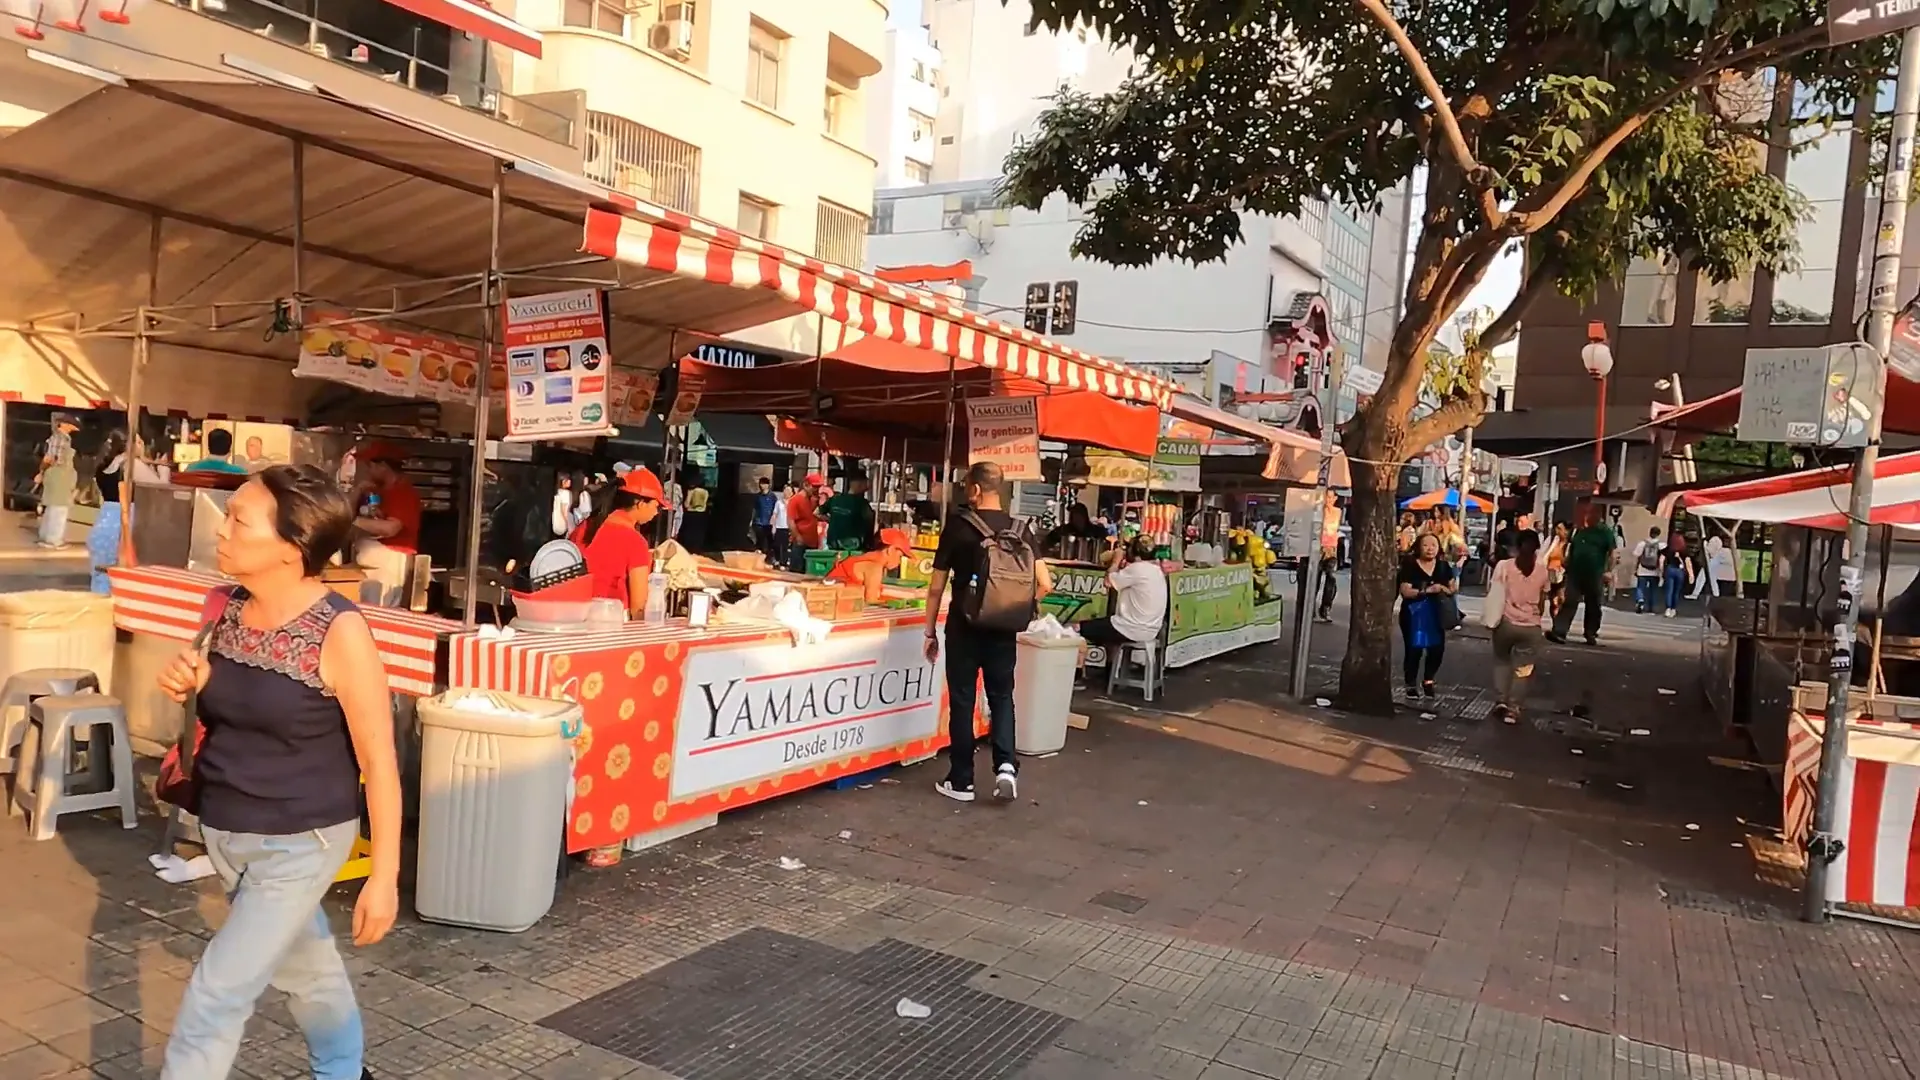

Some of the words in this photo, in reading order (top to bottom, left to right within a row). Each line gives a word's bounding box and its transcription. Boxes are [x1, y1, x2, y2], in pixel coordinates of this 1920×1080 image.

[973, 427, 990, 438] Por
[991, 425, 1034, 439] gentileza
[973, 444, 1003, 455] retirar
[1013, 443, 1036, 454] ficha
[1157, 442, 1198, 455] CANA
[1176, 574, 1211, 595] CALDO
[1212, 573, 1226, 588] de
[783, 735, 828, 763] Desde
[831, 726, 865, 750] 1978
